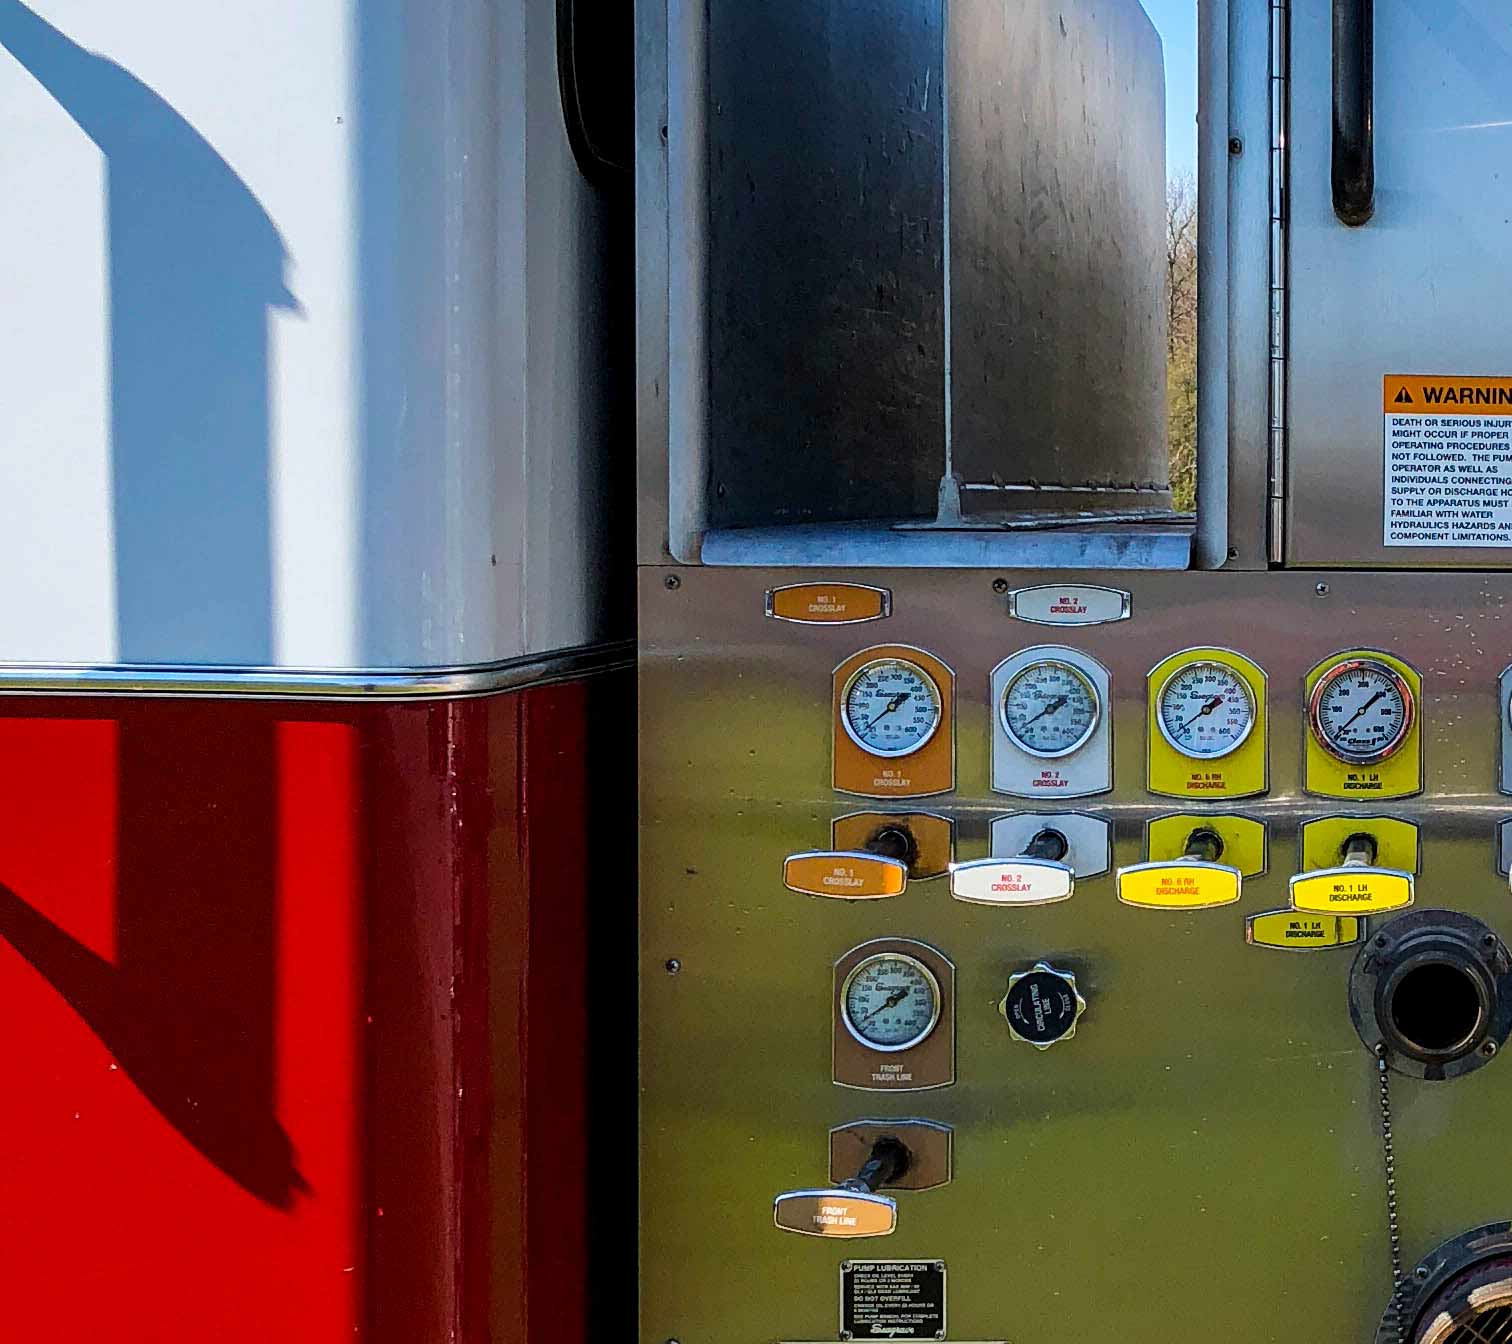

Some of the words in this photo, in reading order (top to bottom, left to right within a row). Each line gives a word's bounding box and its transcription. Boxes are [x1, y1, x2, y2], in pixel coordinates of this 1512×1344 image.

[1392, 418, 1422, 426] DEATH
[1441, 419, 1481, 427] SERIOUS
[1392, 430, 1421, 438] MIGHT
[1392, 442, 1443, 450] OPERATING
[1447, 442, 1509, 450] PROCEDURES
[1414, 453, 1466, 461] FOLLOWED.
[1392, 476, 1448, 484] INDIVIDUALS
[1451, 477, 1512, 485] CONNECTING
[1445, 488, 1498, 496] DISCHARGE
[1427, 499, 1480, 507] APPARATUS
[1391, 521, 1448, 529] HYDRAULICS
[1452, 533, 1511, 541] LIMITATIONS.
[991, 883, 1031, 892] CROSSLAY
[1333, 885, 1347, 893] NO.
[1358, 884, 1368, 892] LH
[1329, 893, 1372, 901] DISCHARGE
[822, 1207, 847, 1216] FRONT
[812, 1216, 837, 1225] TRASH
[839, 1216, 856, 1226] LINE
[871, 1324, 914, 1337] Seagrave
